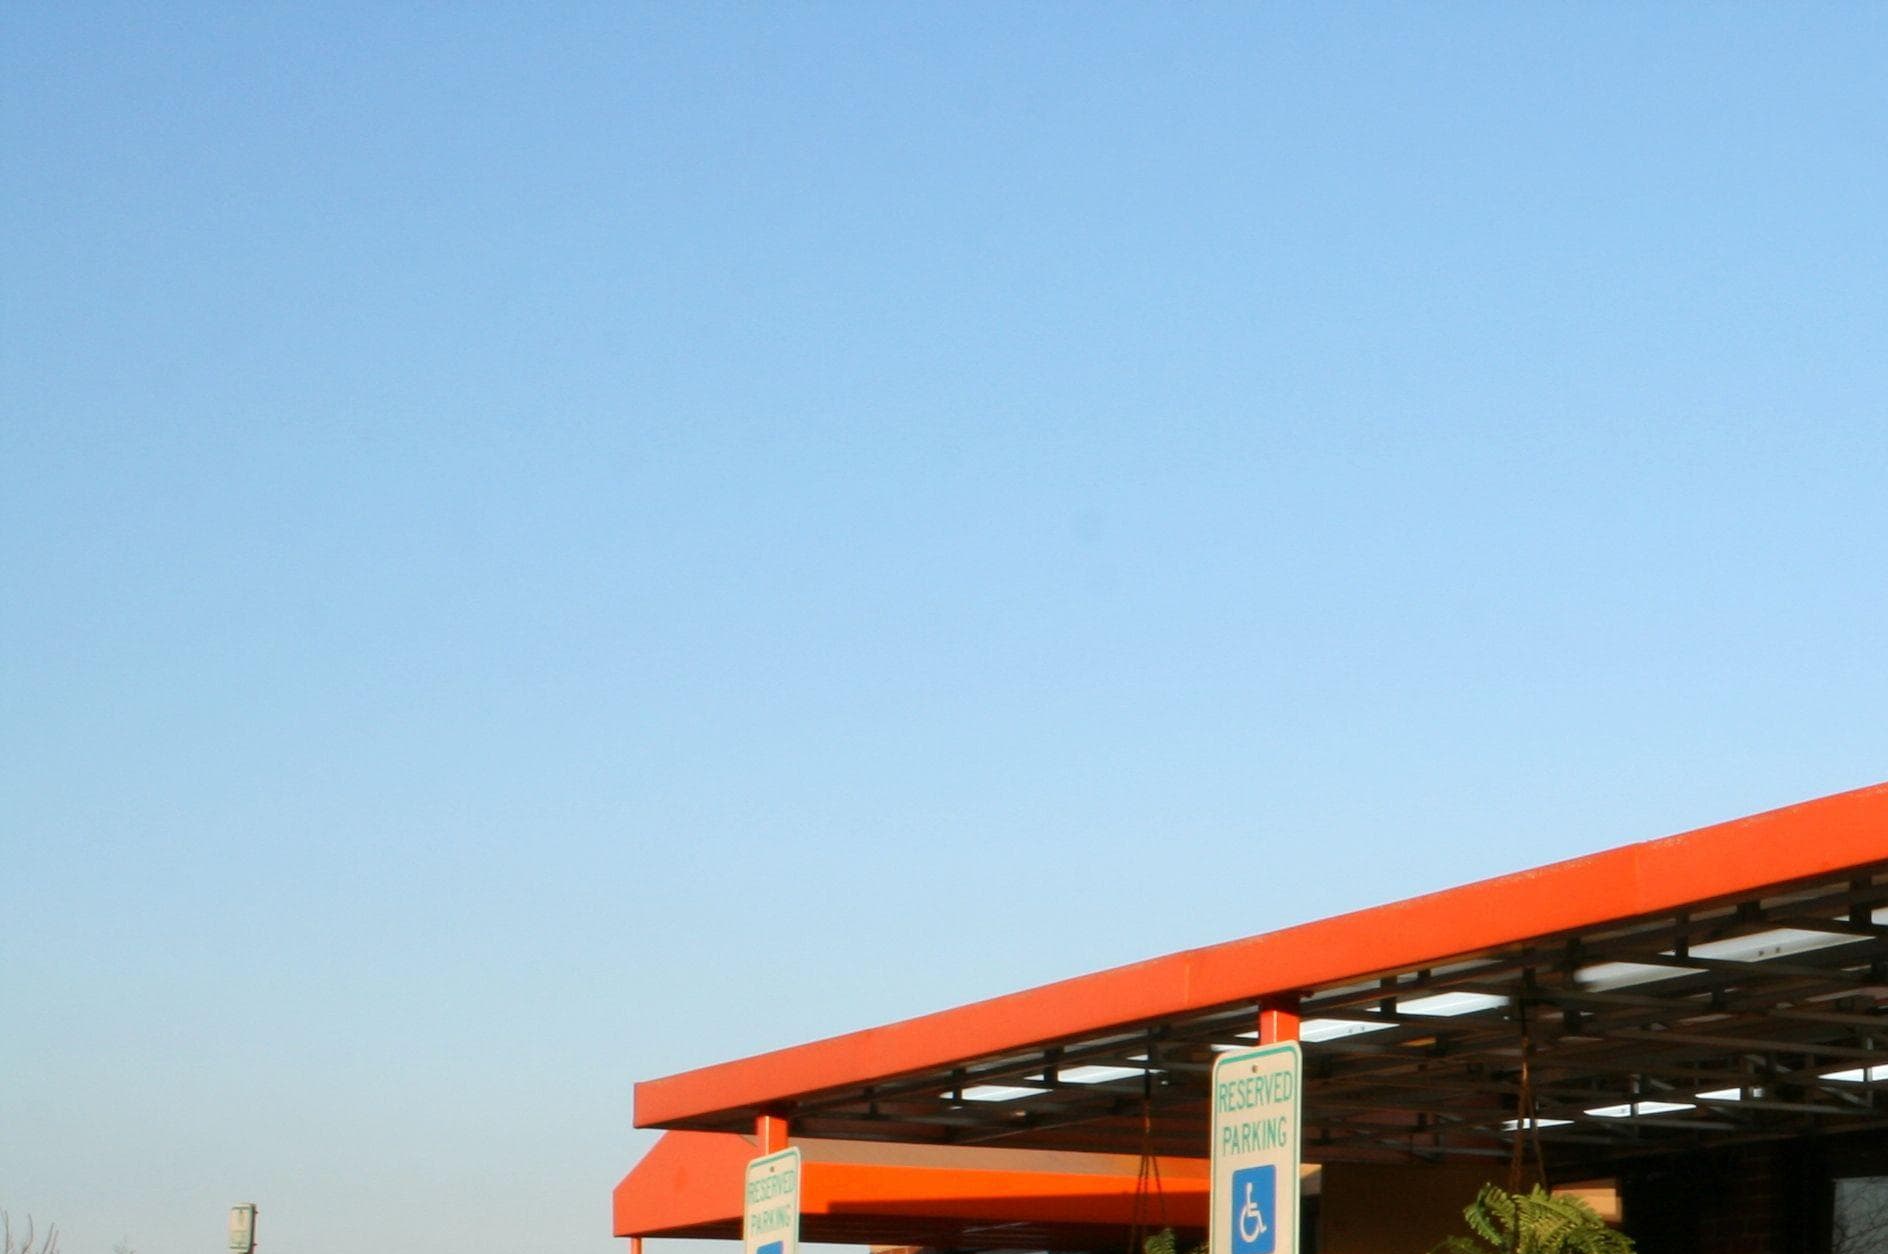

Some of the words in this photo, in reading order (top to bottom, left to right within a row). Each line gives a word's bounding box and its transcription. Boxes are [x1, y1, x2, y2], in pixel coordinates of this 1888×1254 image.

[1218, 1070, 1292, 1113] RESERVED
[1223, 1115, 1287, 1157] PARKING
[748, 1169, 796, 1204] RESERVED
[751, 1203, 791, 1235] PARKING
